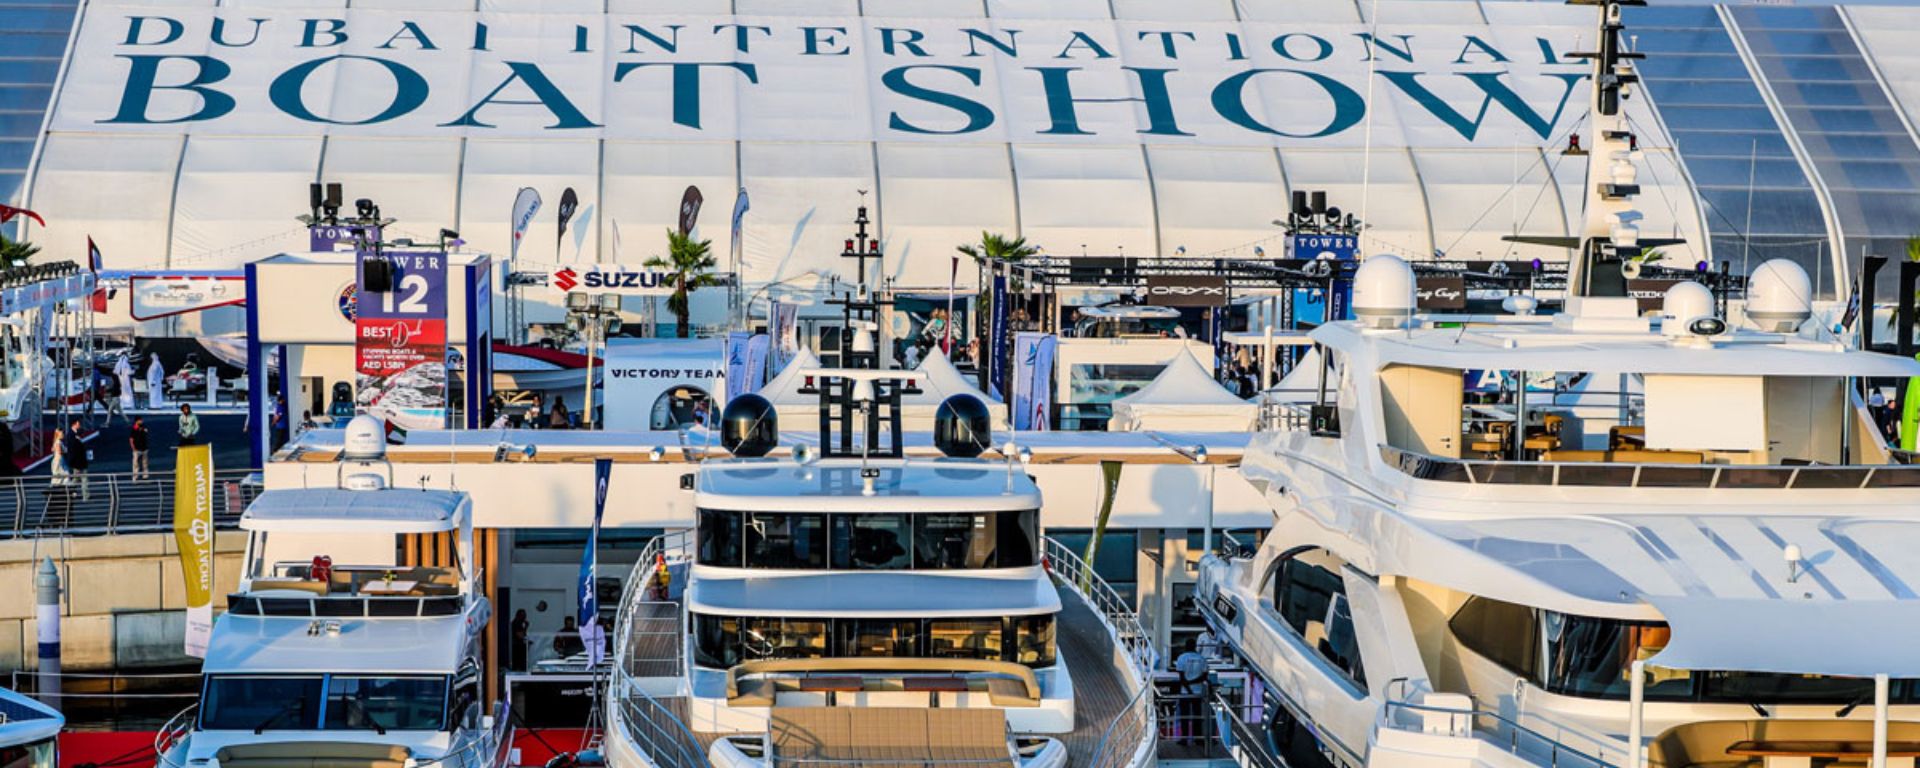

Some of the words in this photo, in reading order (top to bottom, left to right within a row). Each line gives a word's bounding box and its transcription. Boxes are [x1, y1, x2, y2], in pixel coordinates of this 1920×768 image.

[117, 16, 491, 52] DUBAI
[570, 24, 1589, 65] INTERNATIONAL
[94, 53, 760, 131] BOAT
[880, 63, 1592, 140] SHOW
[1298, 237, 1353, 248] TOWER
[1151, 286, 1223, 295] ORYX
[363, 325, 393, 338] BEST
[611, 369, 680, 379] VICTORY
